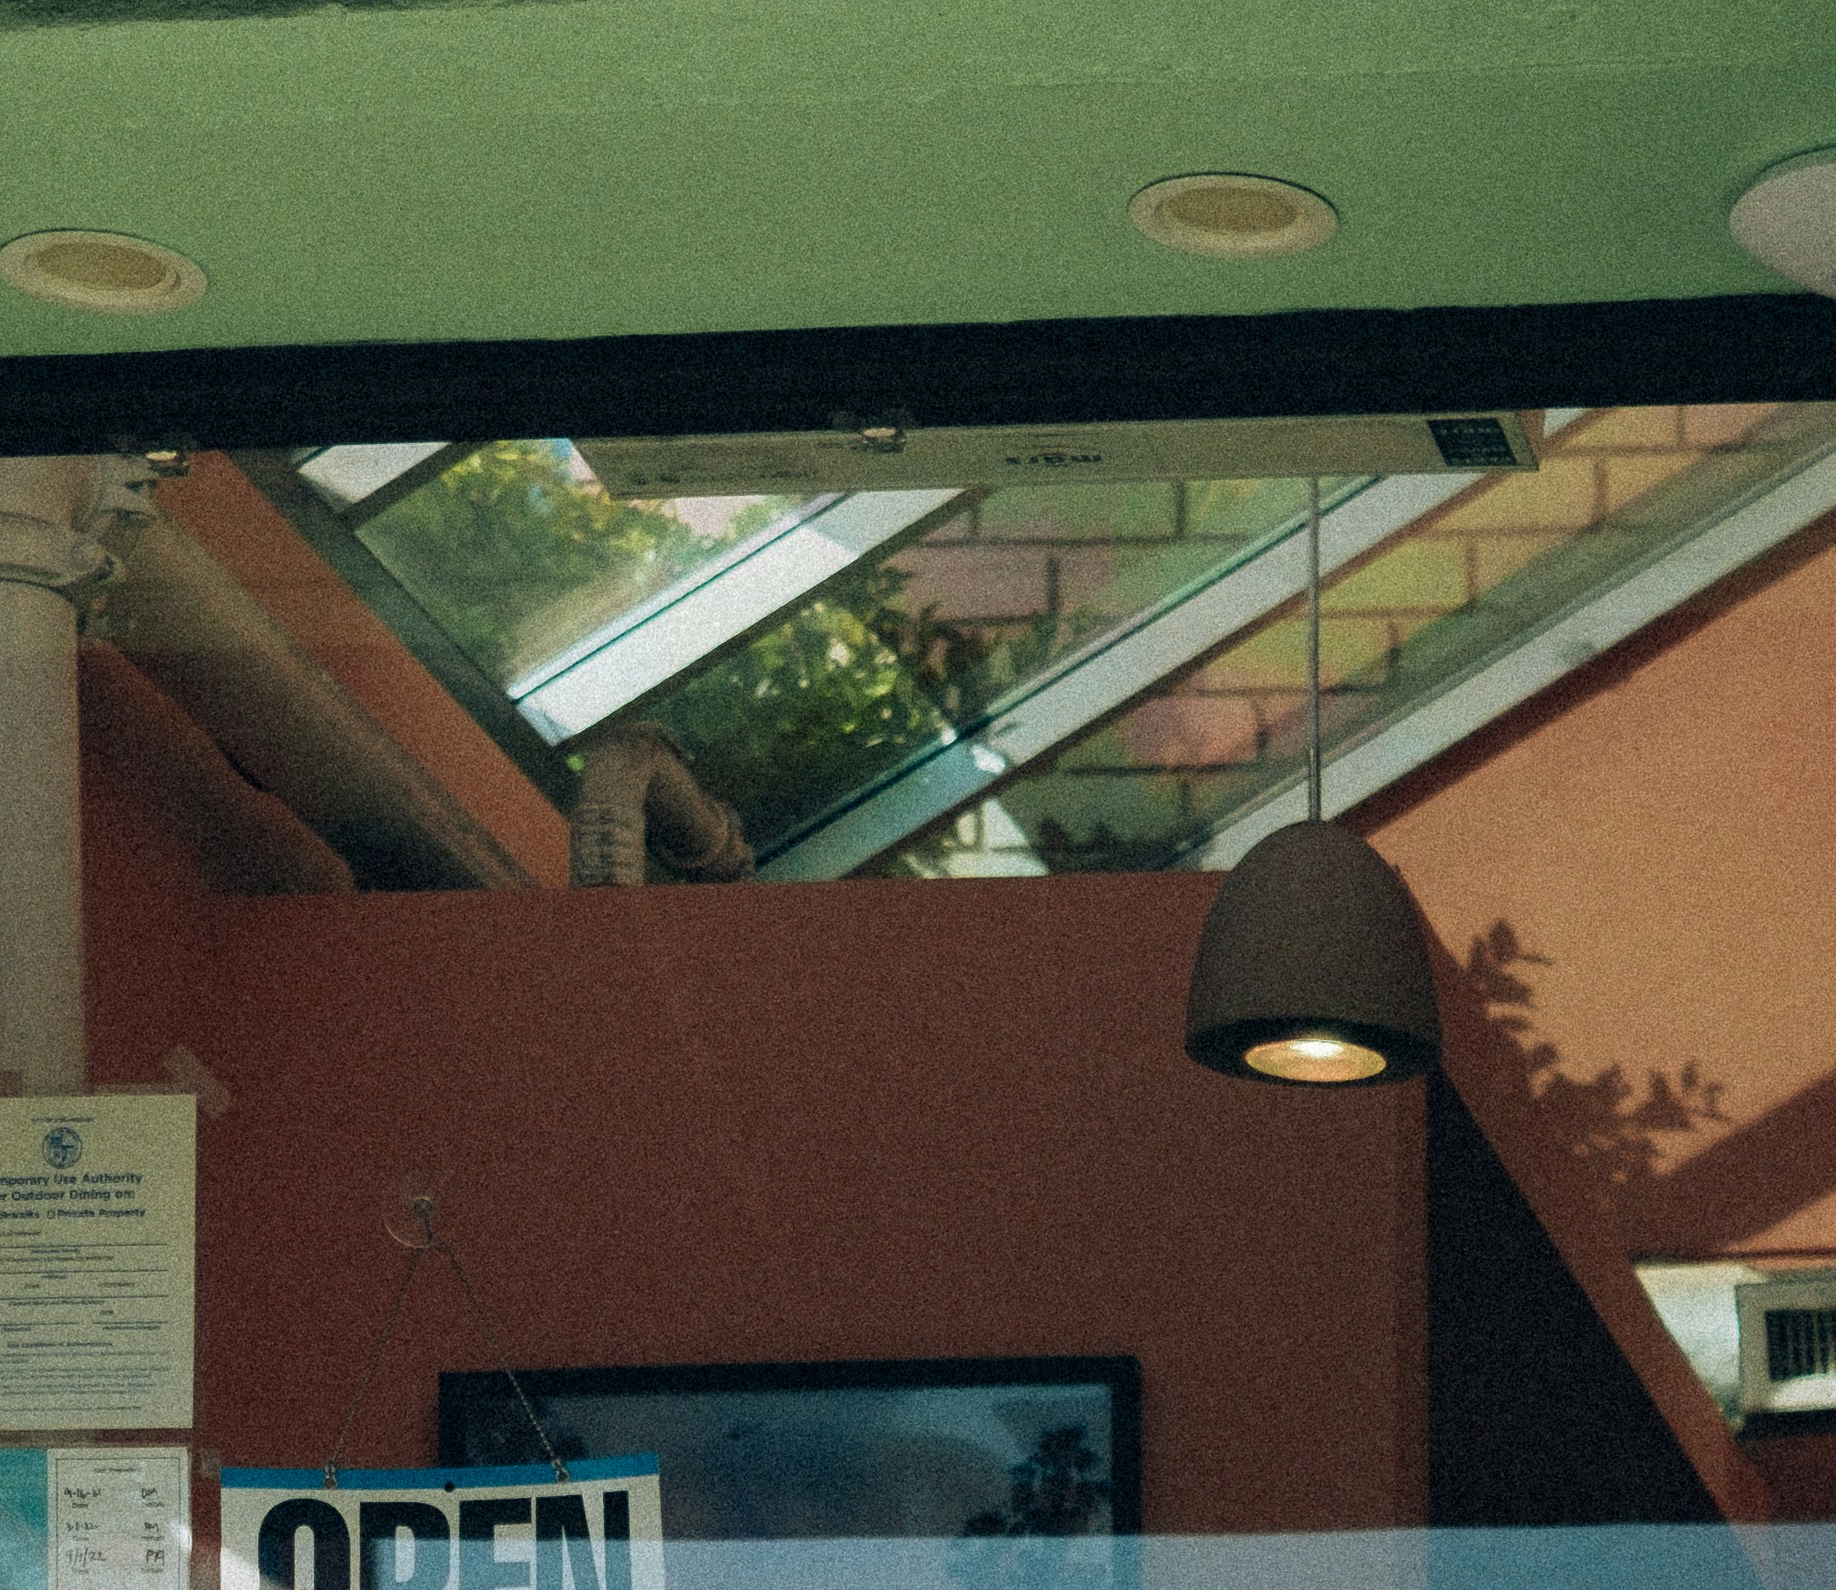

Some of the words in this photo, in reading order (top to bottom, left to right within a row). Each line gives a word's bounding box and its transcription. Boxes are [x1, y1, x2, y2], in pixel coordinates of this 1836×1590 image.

[54, 1175, 77, 1185] Use
[82, 1173, 143, 1185] Authority
[12, 1191, 64, 1200] Outdoor
[70, 1189, 110, 1200] Dining
